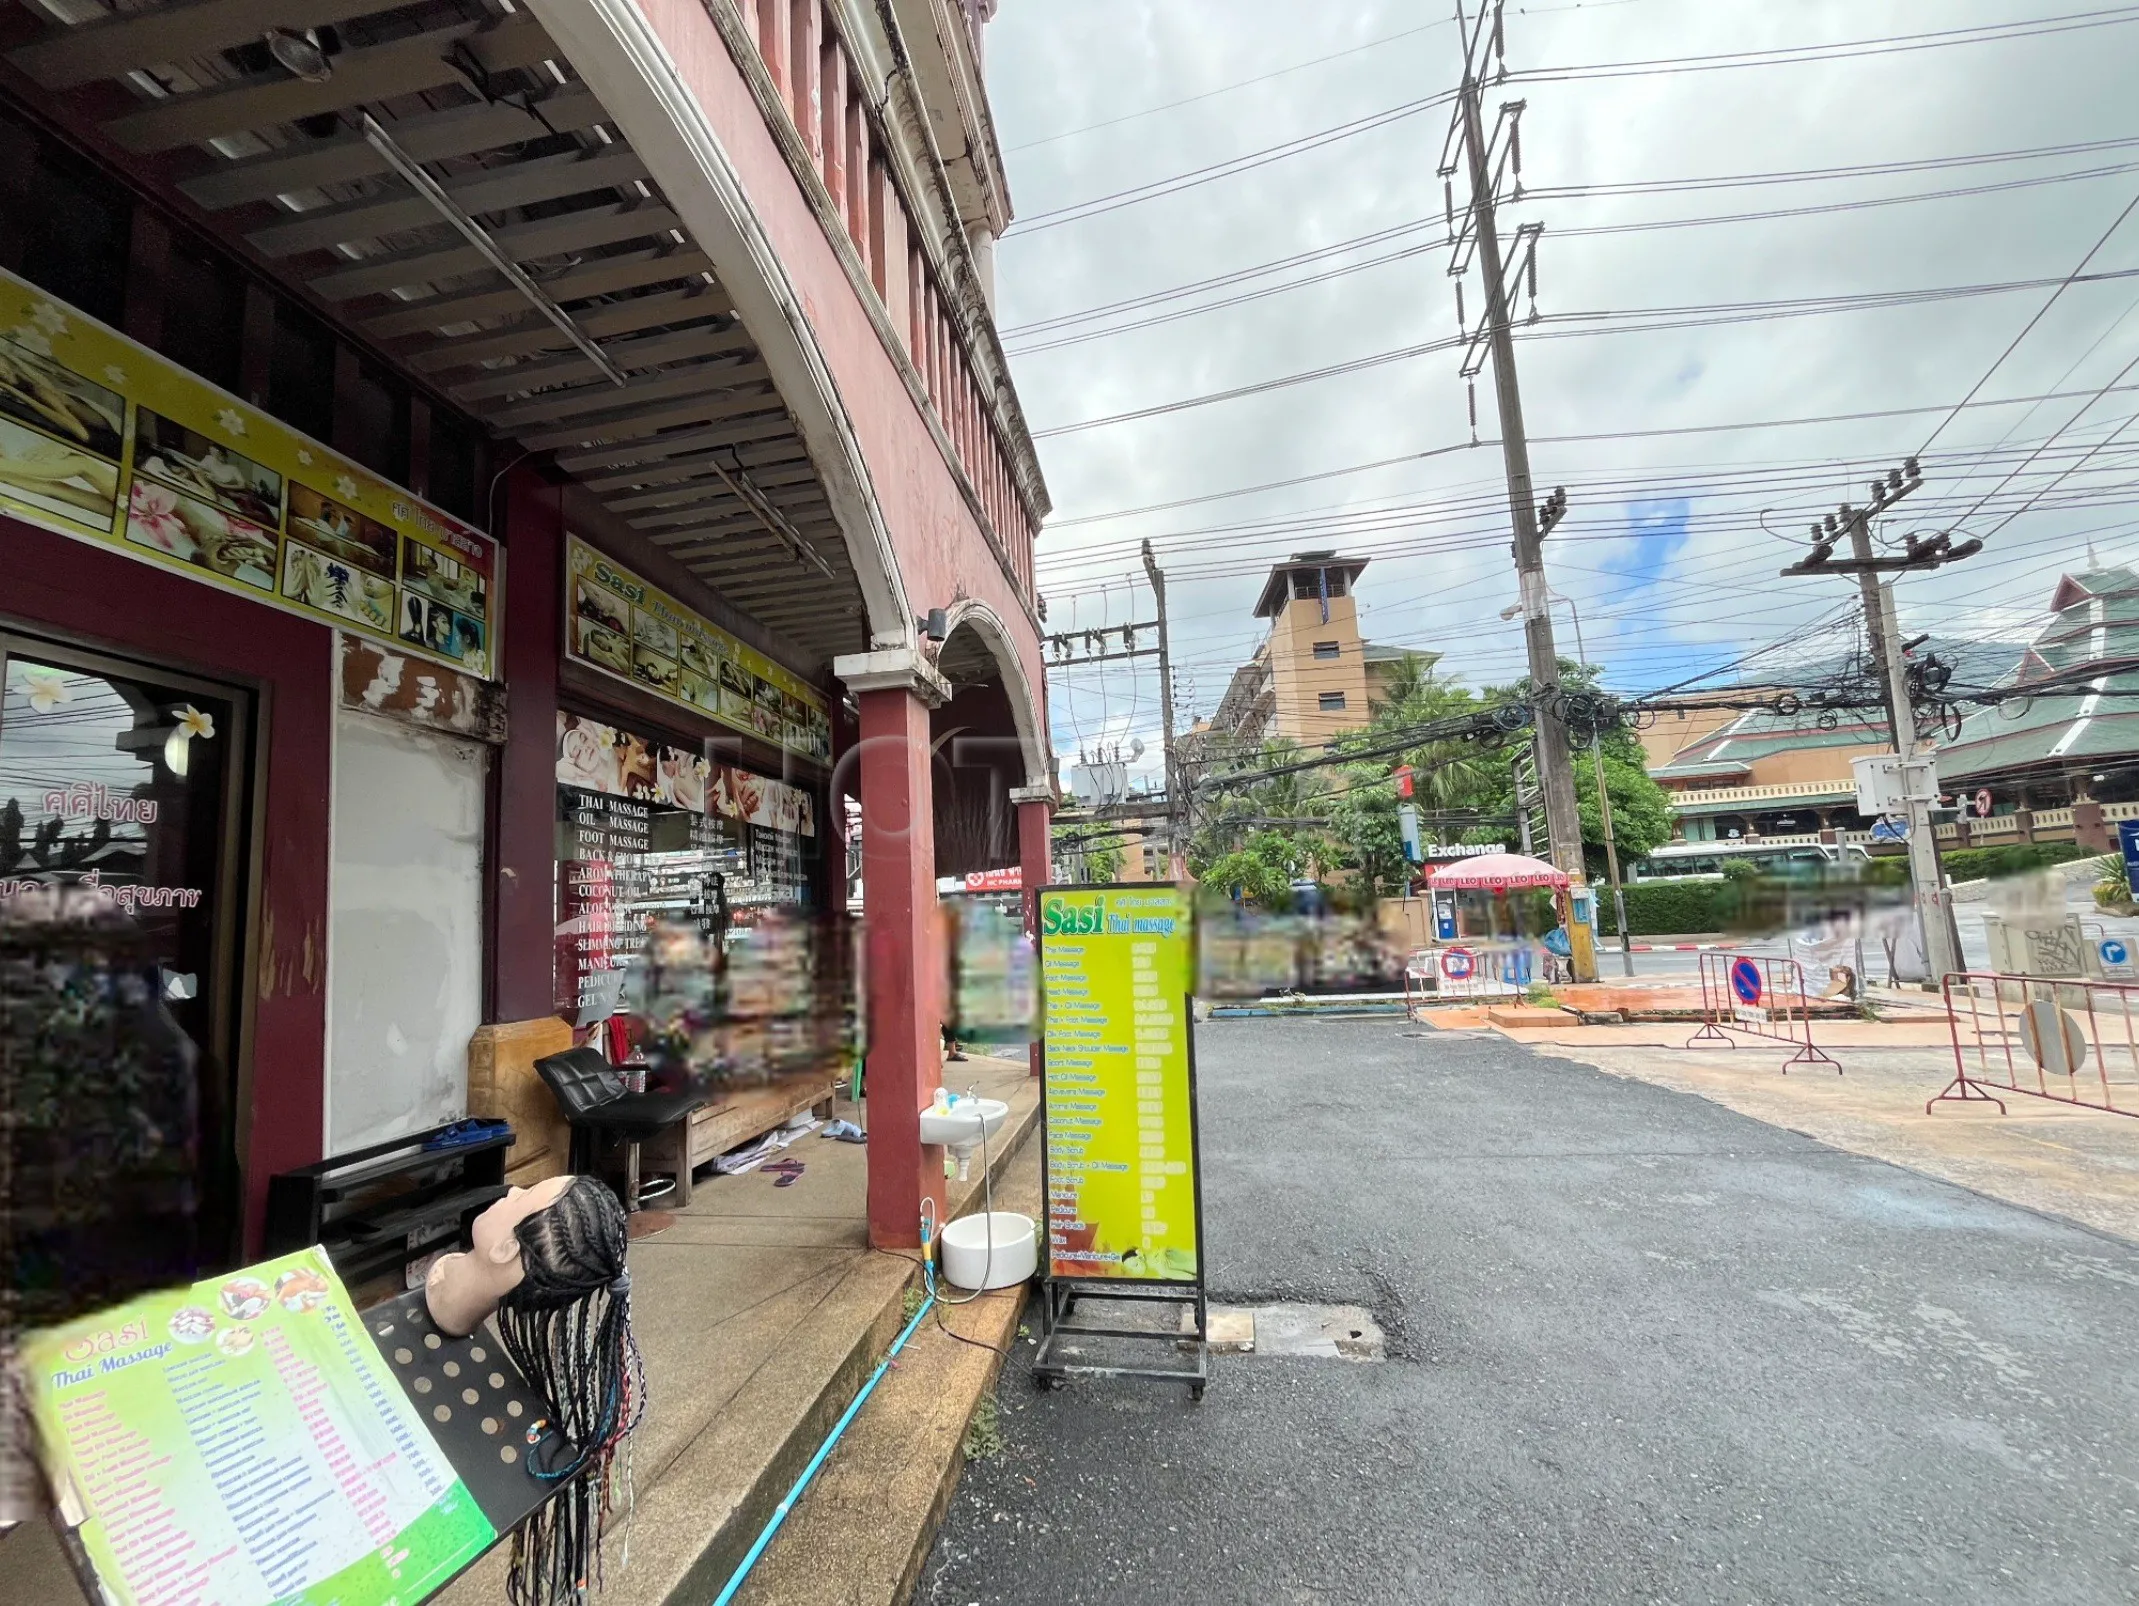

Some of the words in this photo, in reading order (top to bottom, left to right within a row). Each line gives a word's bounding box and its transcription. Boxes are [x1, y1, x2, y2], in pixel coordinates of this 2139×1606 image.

[594, 560, 646, 605] Sasi
[579, 794, 604, 810] THAI
[609, 800, 649, 819] MASSAGE
[579, 812, 596, 826] OIL
[609, 816, 649, 834] MASSAGE
[579, 830, 605, 844] FOOT
[609, 834, 649, 850] MASSAGE
[1428, 843, 1507, 857] Exchange
[579, 848, 606, 861] BACK
[1484, 877, 1502, 885] LEO
[1510, 875, 1528, 884] LEO
[1534, 874, 1549, 882] LEO
[1043, 894, 1106, 935] Sasi
[1107, 912, 1130, 934] Thai
[1133, 917, 1175, 937] massage
[51, 1364, 95, 1389] Thai
[99, 1342, 173, 1374] Massage
